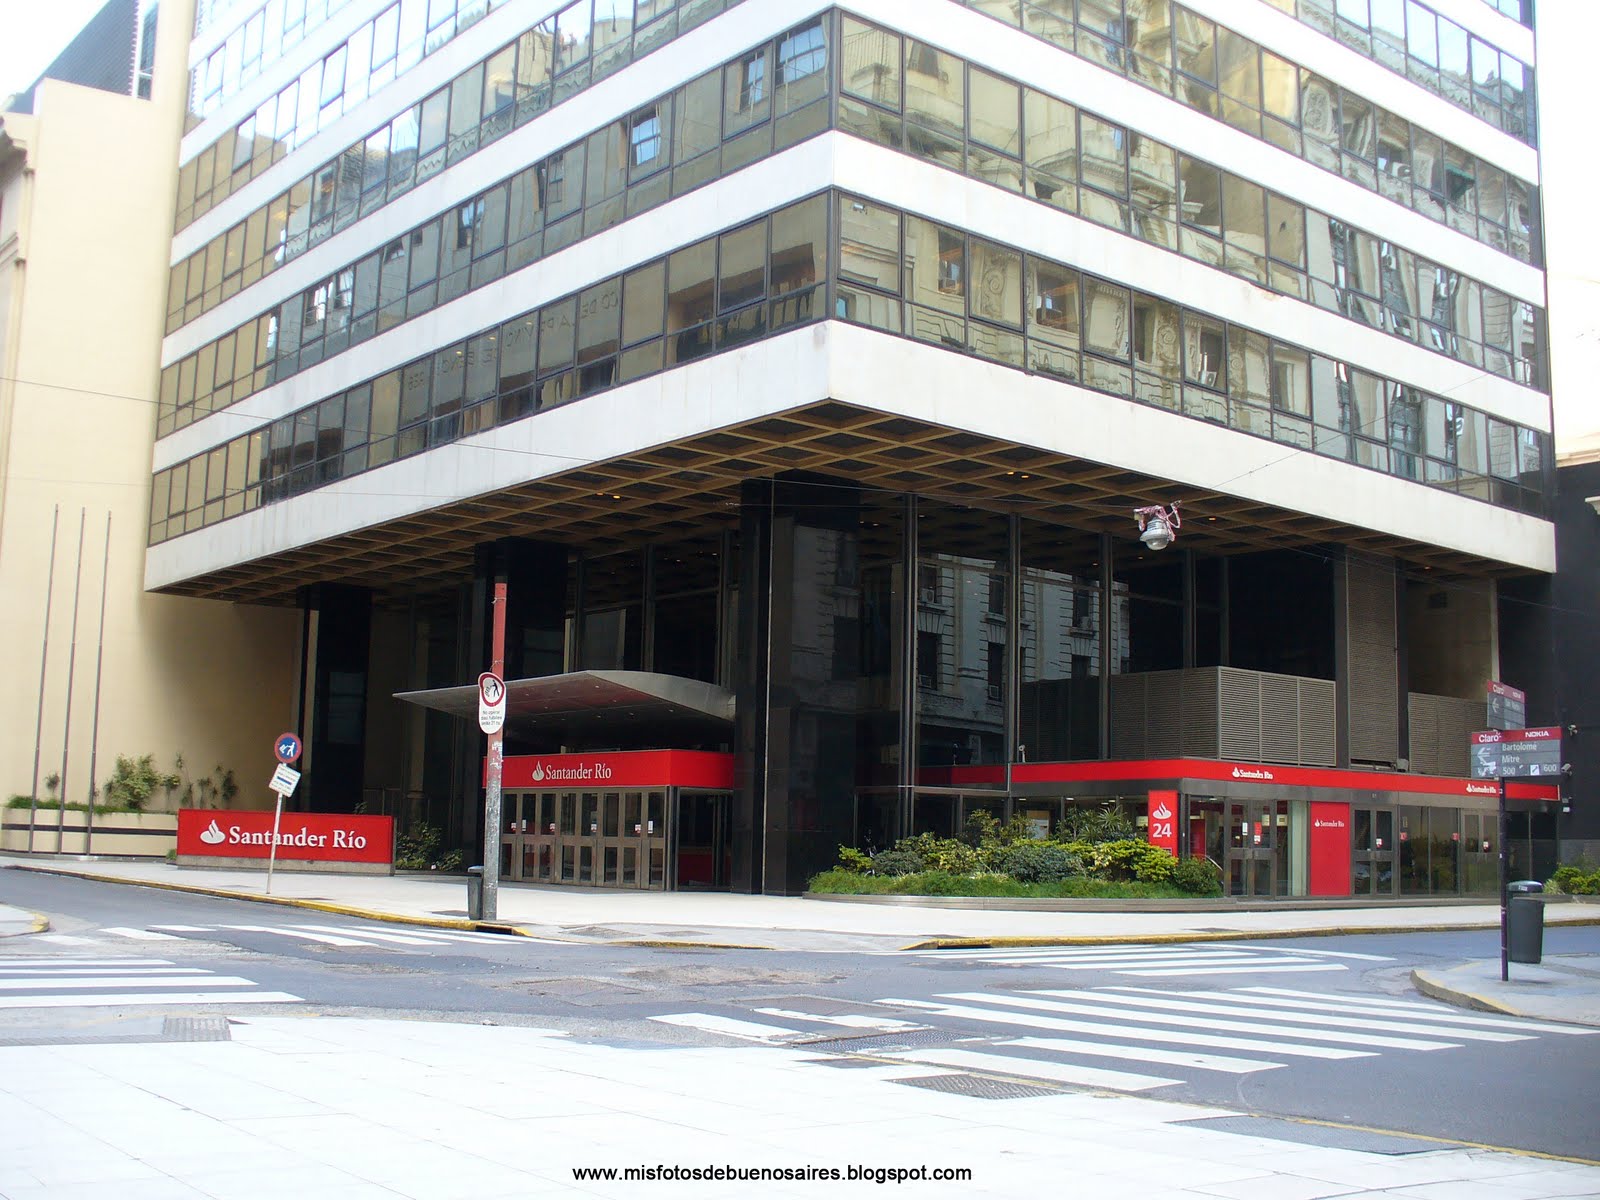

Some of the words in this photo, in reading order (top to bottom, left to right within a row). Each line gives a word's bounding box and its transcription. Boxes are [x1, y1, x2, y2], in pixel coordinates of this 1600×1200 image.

[1524, 730, 1550, 738] NOKIA
[1502, 742, 1537, 752] Bartolomé
[1501, 755, 1520, 764] Mitre
[545, 762, 593, 781] Santander
[594, 762, 612, 780] Río
[1502, 766, 1516, 775] 500
[1543, 763, 1557, 773] 600
[1239, 768, 1264, 779] Santander
[1152, 822, 1173, 838] 24
[229, 825, 328, 848] Santander
[331, 828, 367, 850] Río
